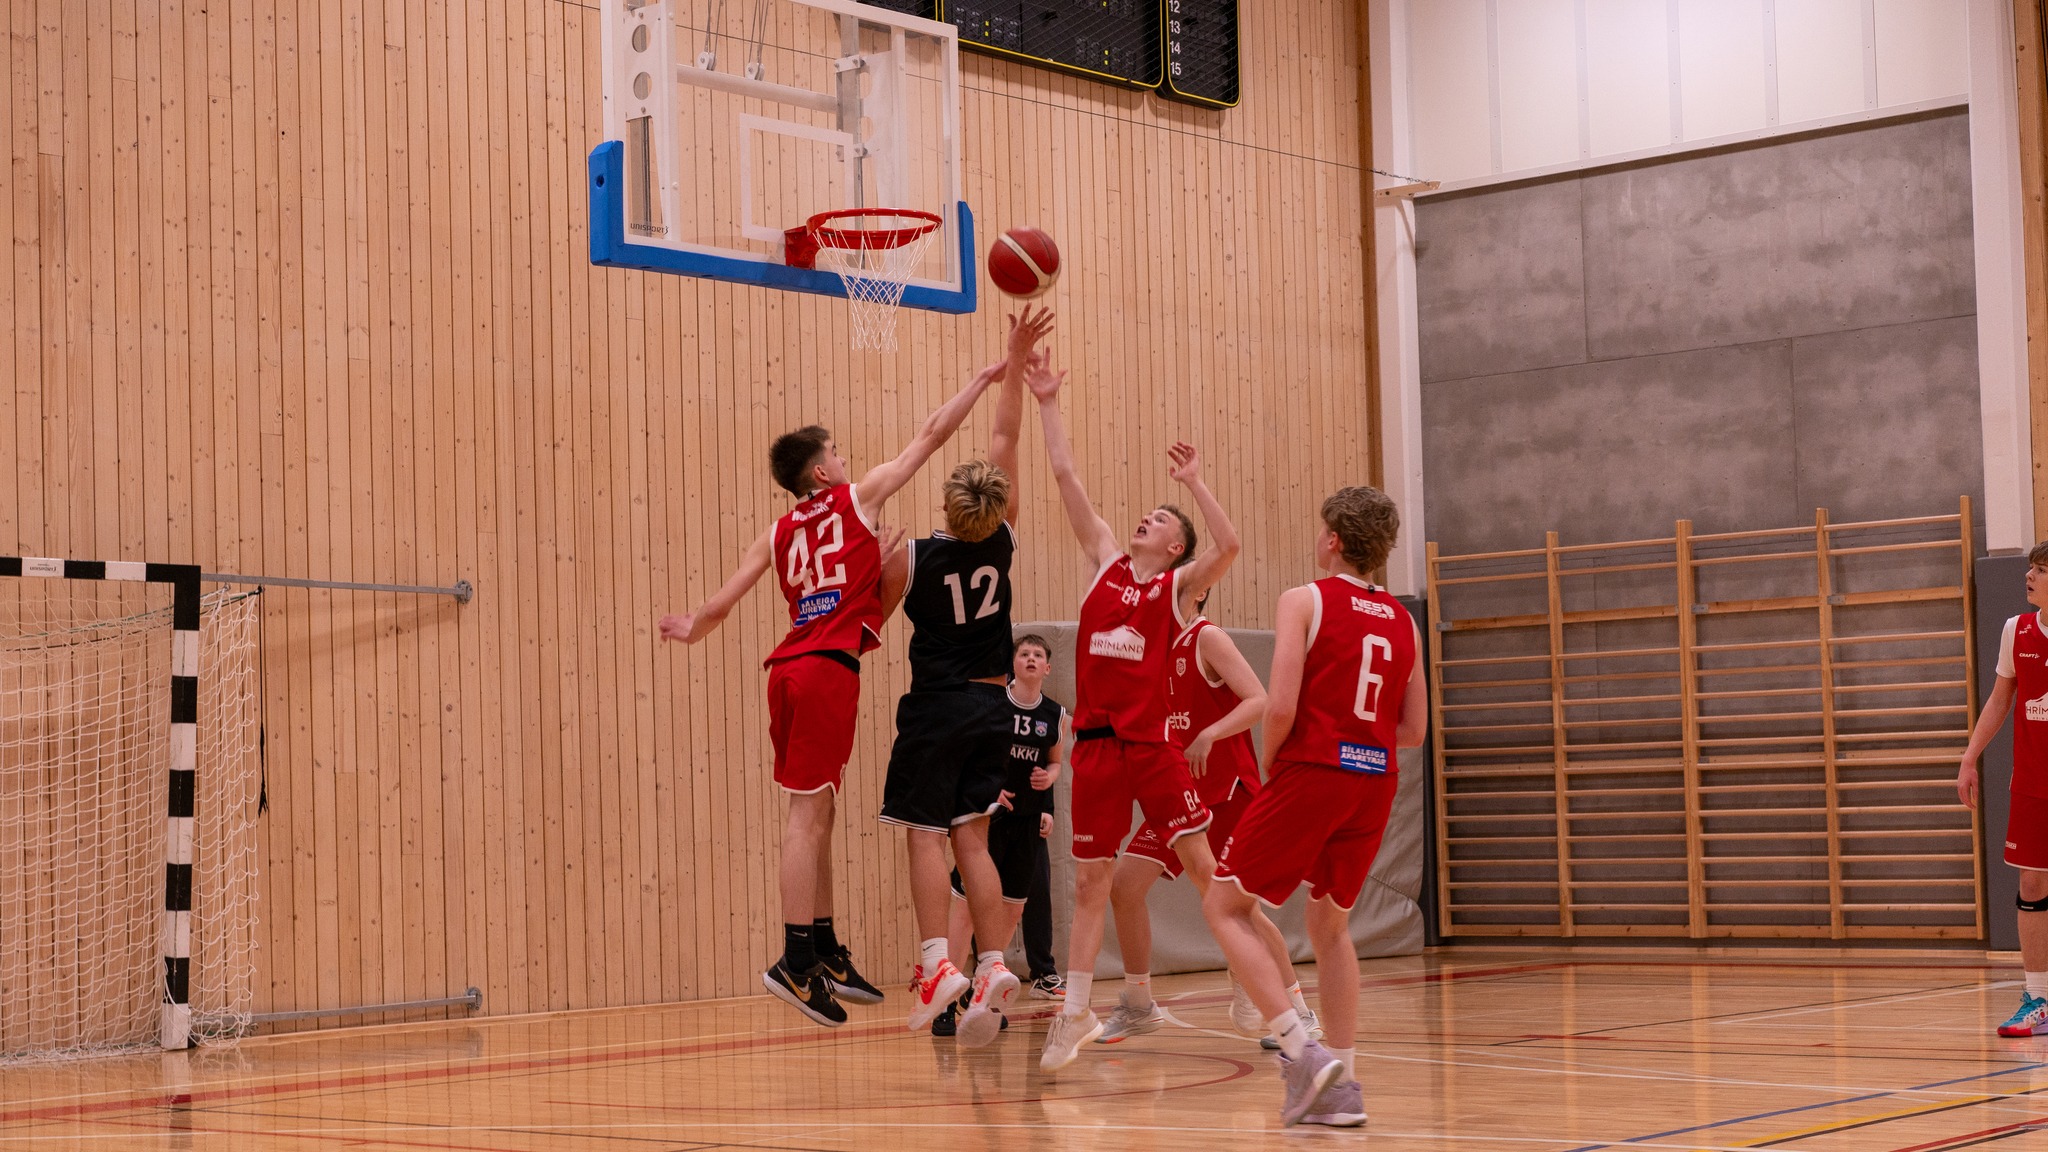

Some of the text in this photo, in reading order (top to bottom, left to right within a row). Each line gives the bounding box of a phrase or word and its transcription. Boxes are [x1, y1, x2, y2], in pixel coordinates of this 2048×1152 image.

[1169, 0, 1180, 13] 12
[1169, 20, 1180, 34] 13
[1170, 41, 1181, 54] 14
[1171, 62, 1182, 75] 15
[787, 512, 847, 598] 42
[801, 596, 835, 609] ALEIGA
[944, 565, 1000, 624] 12
[1121, 586, 1141, 607] 84
[1353, 633, 1392, 722] 6
[1013, 714, 1032, 736] 13
[1010, 746, 1039, 762] AKKI
